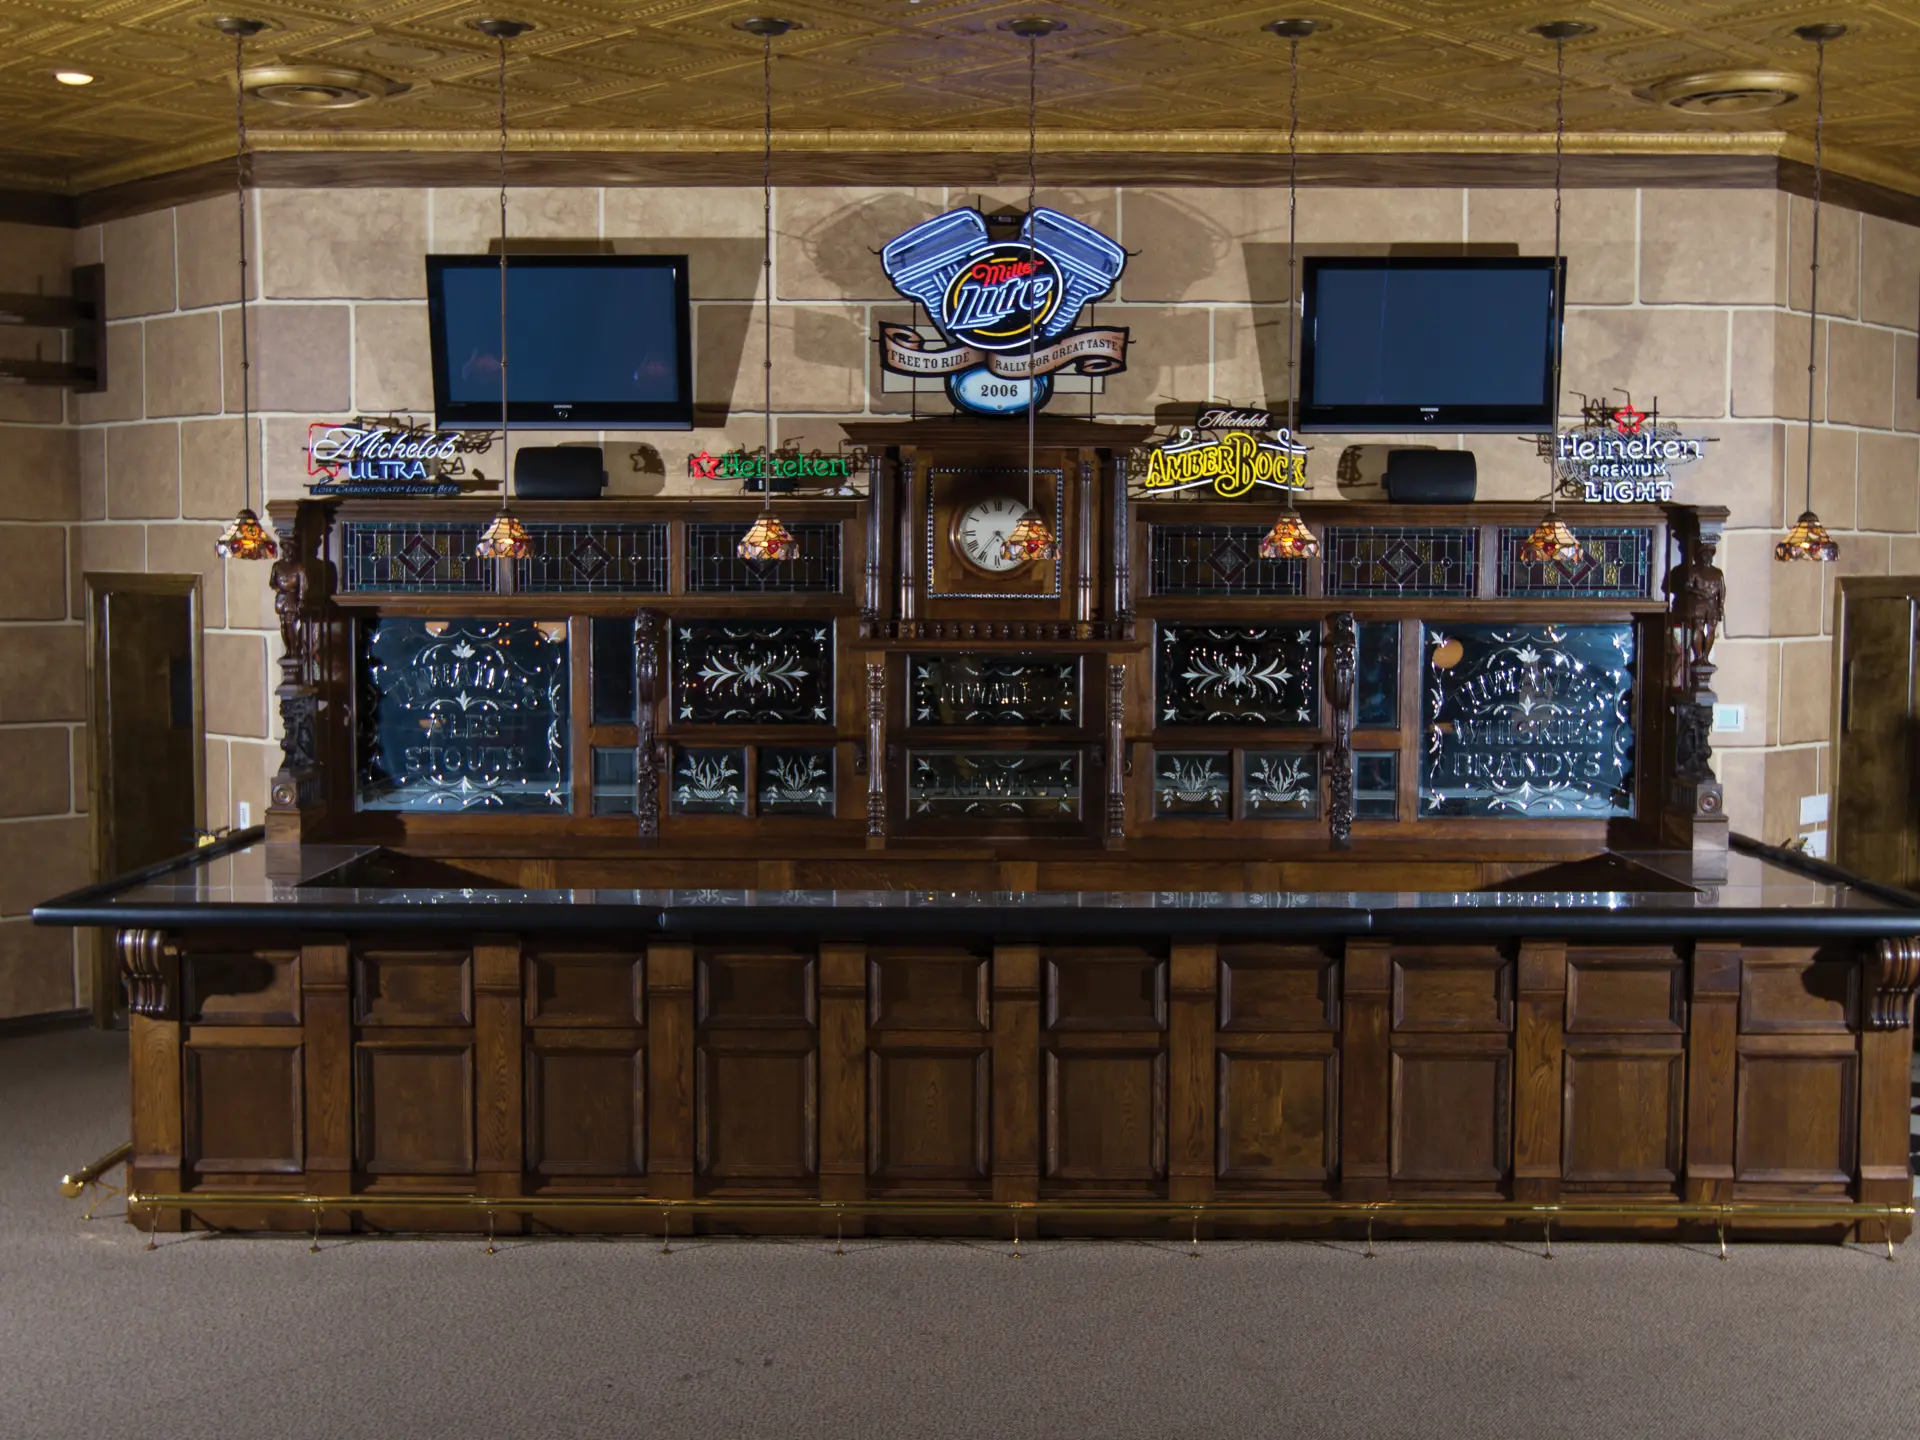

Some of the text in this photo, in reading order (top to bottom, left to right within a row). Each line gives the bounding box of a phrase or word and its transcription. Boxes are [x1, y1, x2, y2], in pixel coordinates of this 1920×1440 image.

[947, 277, 1053, 329] Lite
[891, 352, 969, 368] FREE TO RIDE
[995, 339, 1117, 371] RALLY OR GREAT TASTE
[981, 384, 1018, 397] 2006
[1198, 411, 1269, 428] Michelob
[313, 428, 459, 459] Michelob
[1557, 433, 1704, 460] Heineken
[348, 461, 427, 479] ULTRA
[720, 453, 849, 477] Heineken
[1590, 463, 1666, 477] PREMIUM
[406, 485, 433, 493] LIGHT
[1584, 482, 1674, 503] LIGHT
[426, 714, 501, 739] ALES
[1454, 720, 1603, 745] WHISKIES
[405, 746, 525, 772] STOUTS
[1453, 752, 1601, 777] BRANDYS
